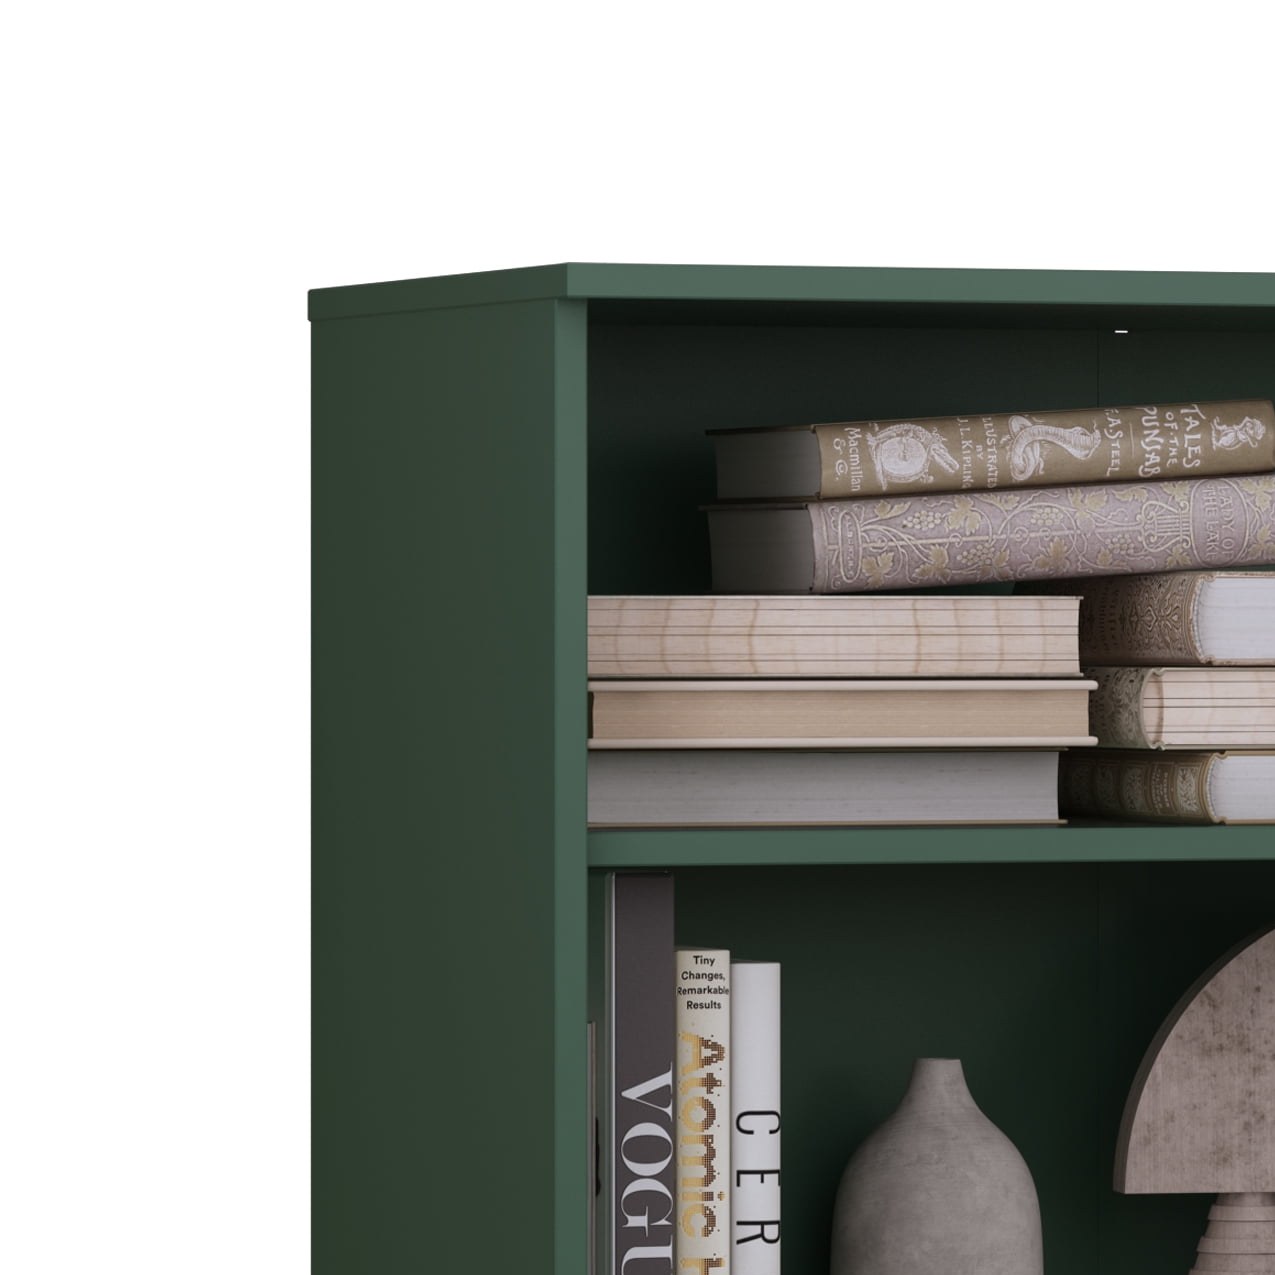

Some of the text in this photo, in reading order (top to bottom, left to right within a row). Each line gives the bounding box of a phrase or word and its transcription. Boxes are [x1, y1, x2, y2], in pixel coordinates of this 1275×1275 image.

[844, 427, 863, 491] Macmillan
[976, 445, 984, 460] BY
[982, 417, 998, 488] LLUSTRATED
[1136, 406, 1164, 477] PUNJAB
[1164, 412, 1179, 467] OF THE
[1180, 404, 1206, 468] TALES
[1218, 486, 1236, 532] LADY
[681, 971, 726, 982] Changes,
[693, 955, 716, 967] Tiny
[677, 986, 730, 996] Remarkable
[686, 1000, 722, 1010] Results
[681, 1031, 726, 1238] Atomic
